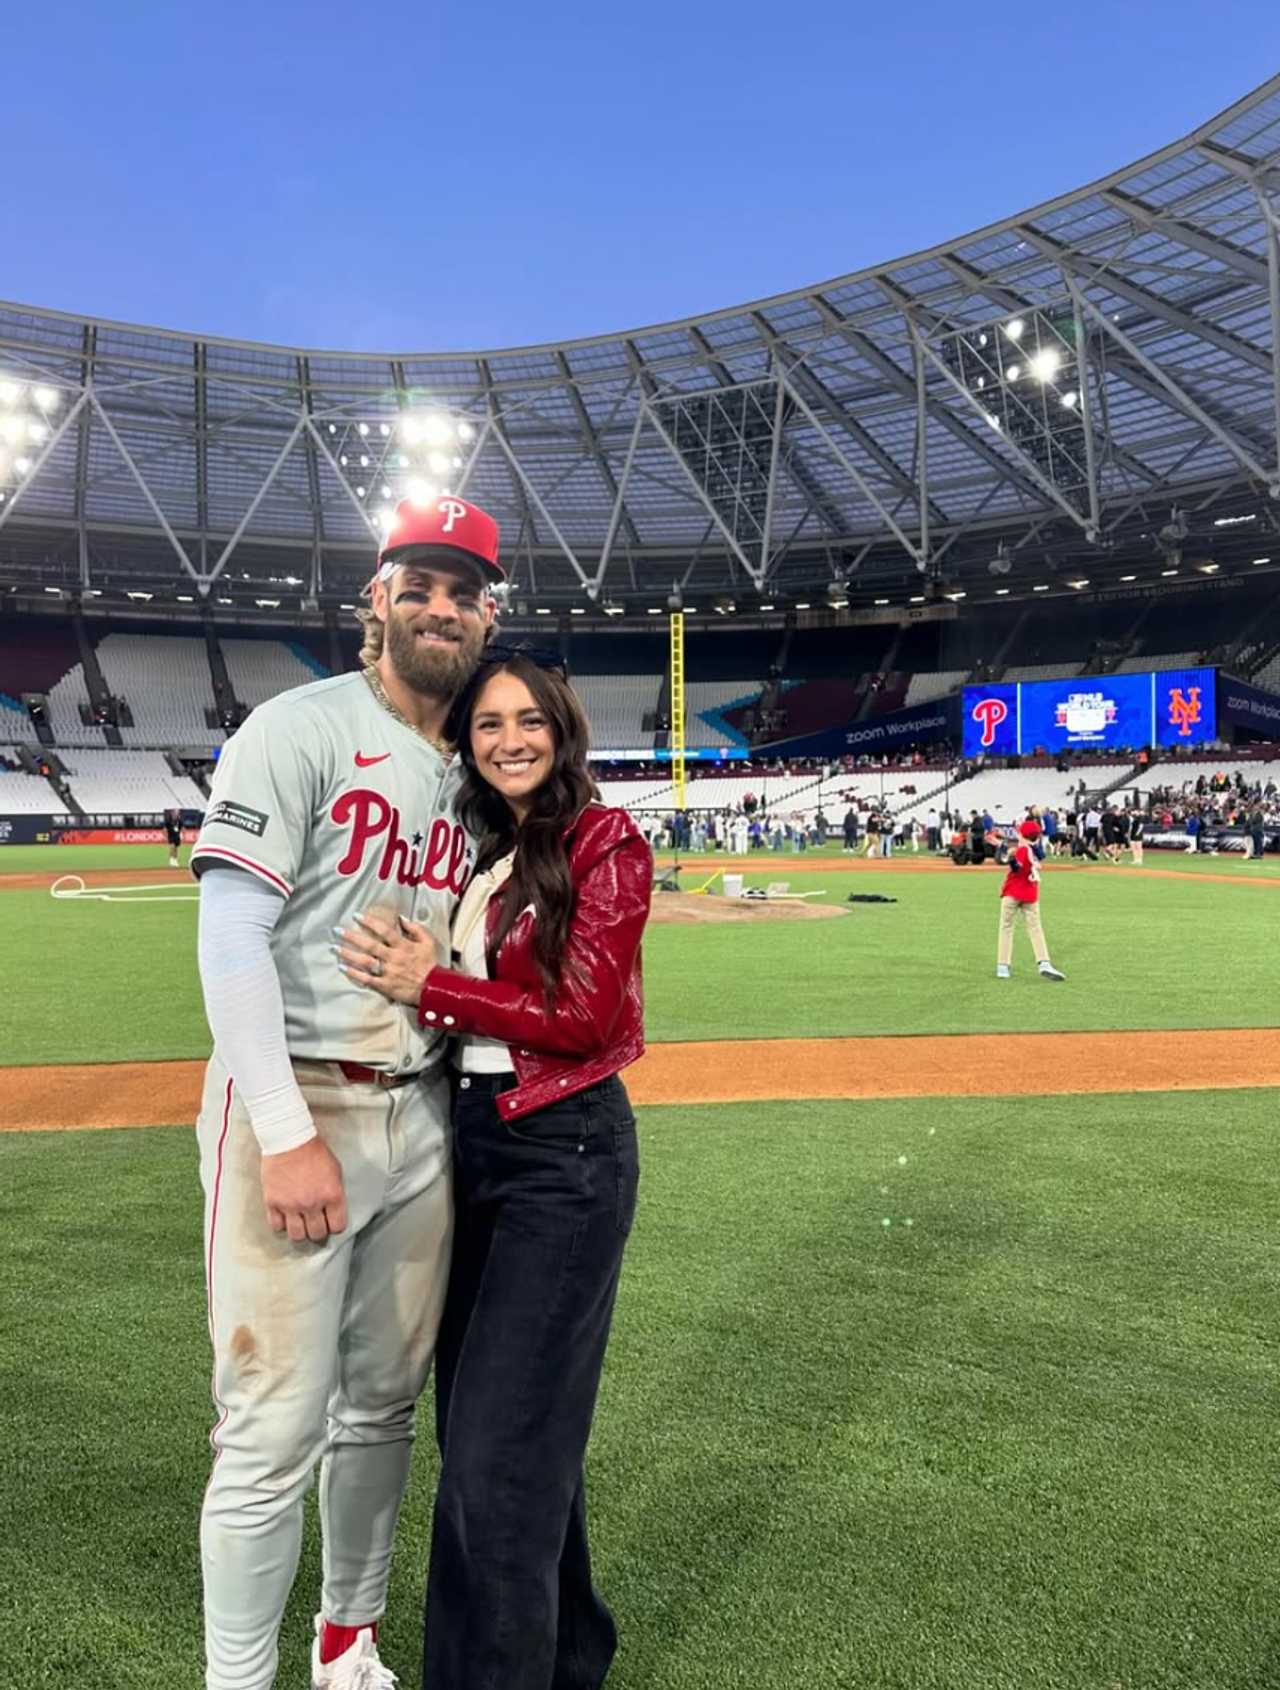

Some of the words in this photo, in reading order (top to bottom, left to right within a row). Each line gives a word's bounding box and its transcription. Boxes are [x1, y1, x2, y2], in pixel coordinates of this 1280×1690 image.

[438, 500, 467, 532] P
[846, 727, 885, 744] zoom
[886, 716, 946, 735] Workplace
[972, 698, 1007, 747] P
[1169, 687, 1201, 736] NY
[330, 788, 471, 898] Philli
